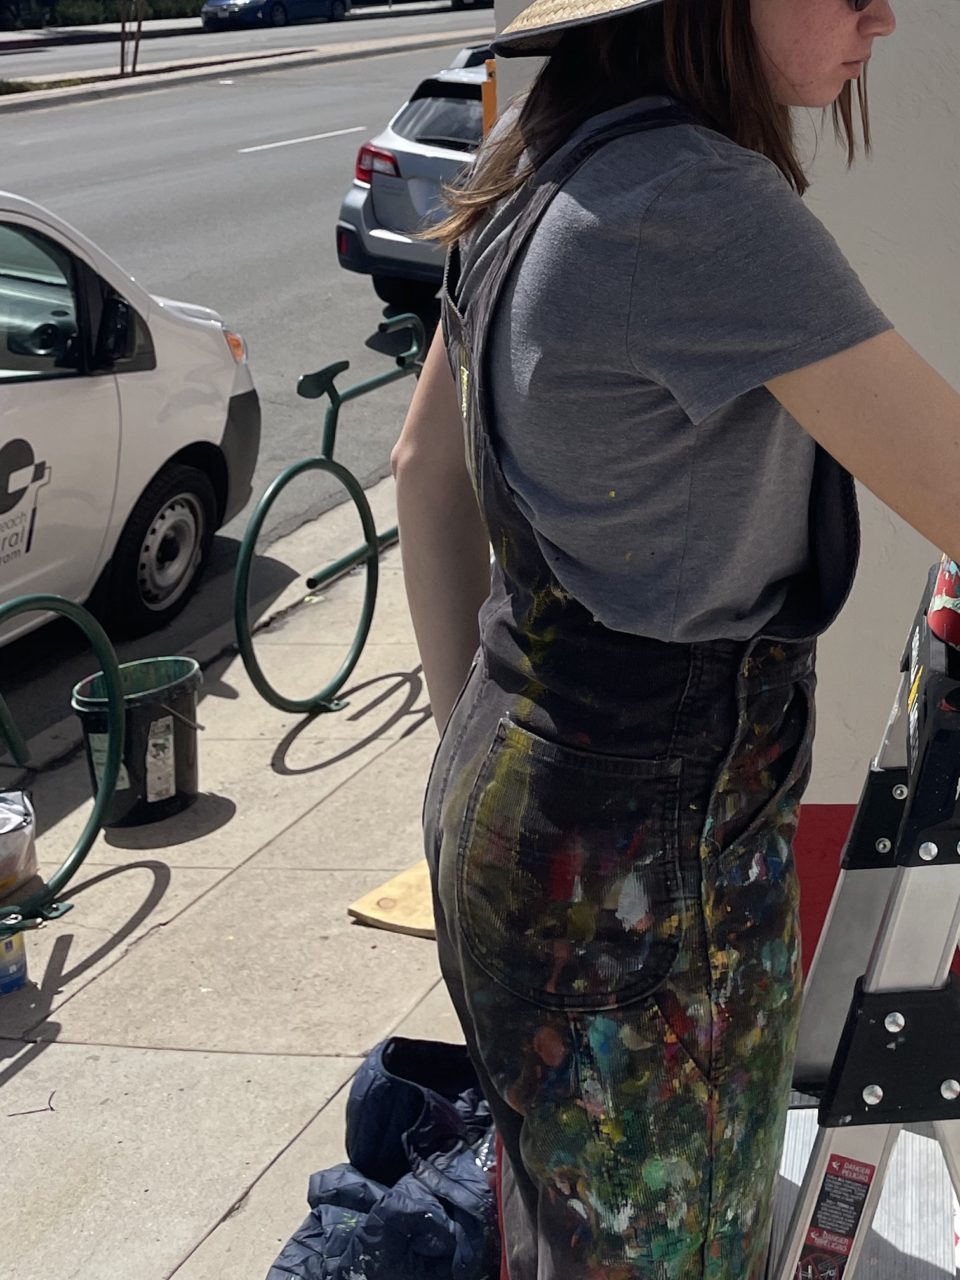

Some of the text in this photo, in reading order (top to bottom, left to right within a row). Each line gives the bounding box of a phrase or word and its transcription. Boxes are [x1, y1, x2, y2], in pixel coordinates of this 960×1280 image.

[841, 1169, 869, 1181] PELIGRO
[844, 1163, 871, 1175] DANGER
[822, 1231, 849, 1246] DANGER
